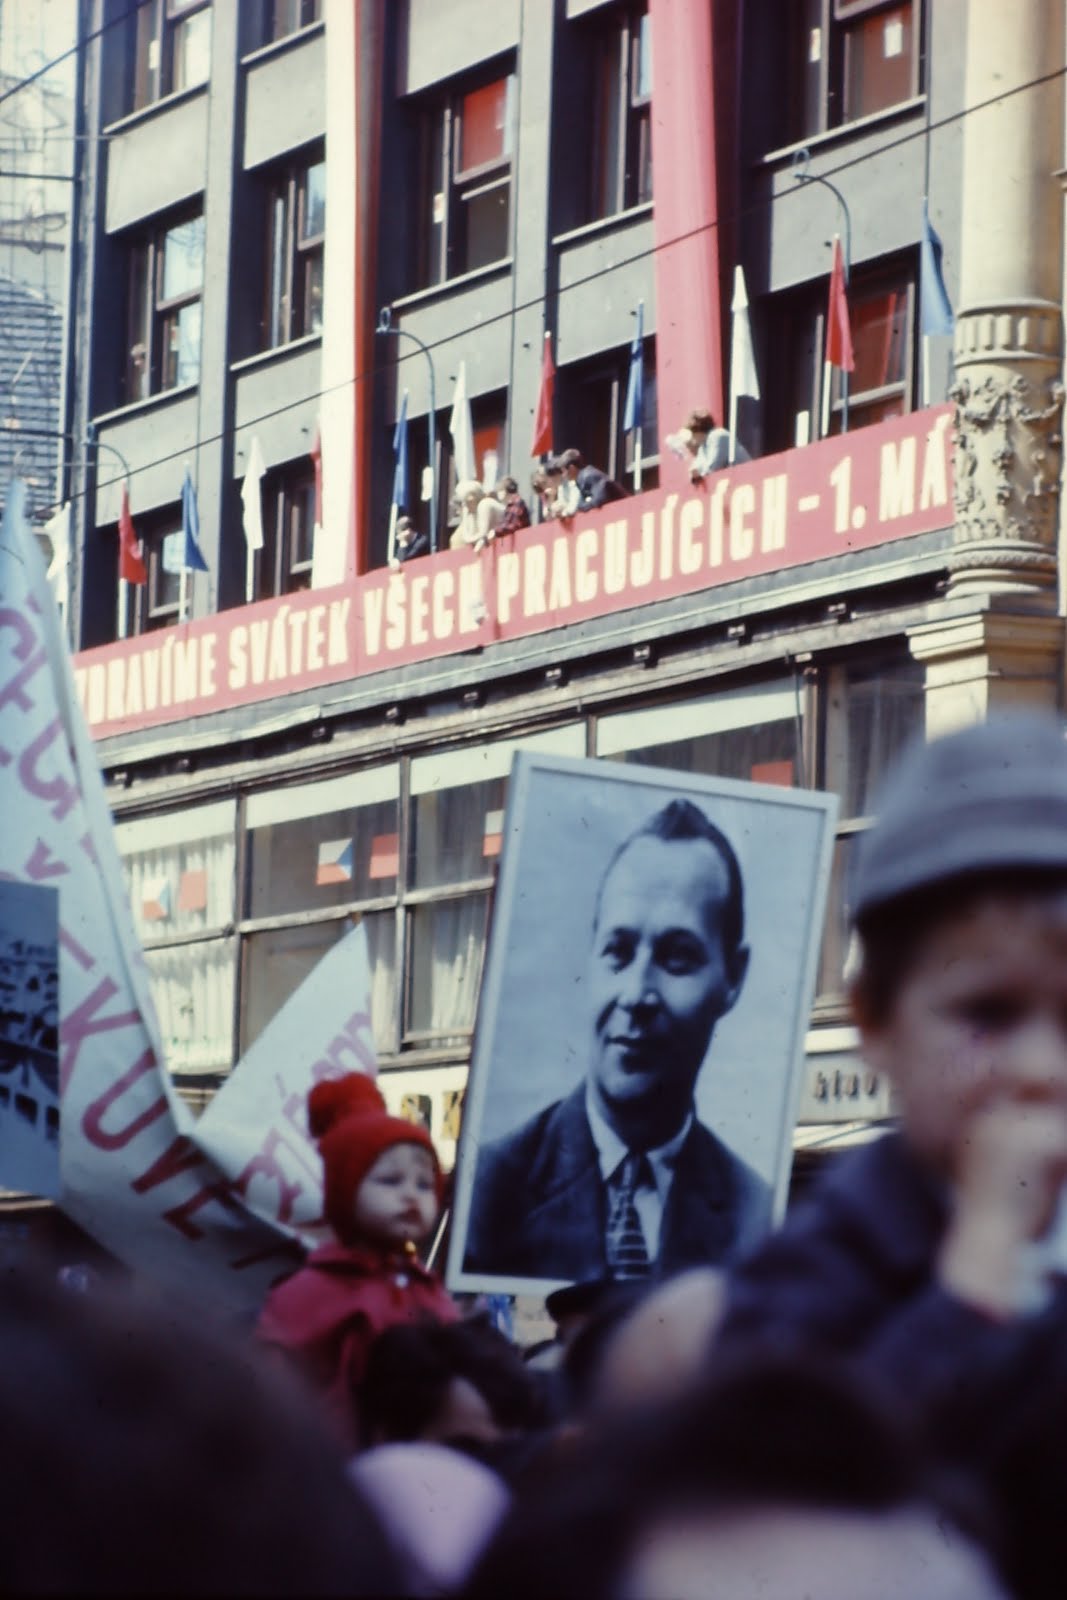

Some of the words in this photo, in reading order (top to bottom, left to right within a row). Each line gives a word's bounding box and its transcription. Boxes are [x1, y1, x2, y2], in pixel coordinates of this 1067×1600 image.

[228, 597, 351, 690] SVÁTEK
[497, 473, 788, 624] PRACUJÍCÍCH
[830, 456, 866, 533] 1.
